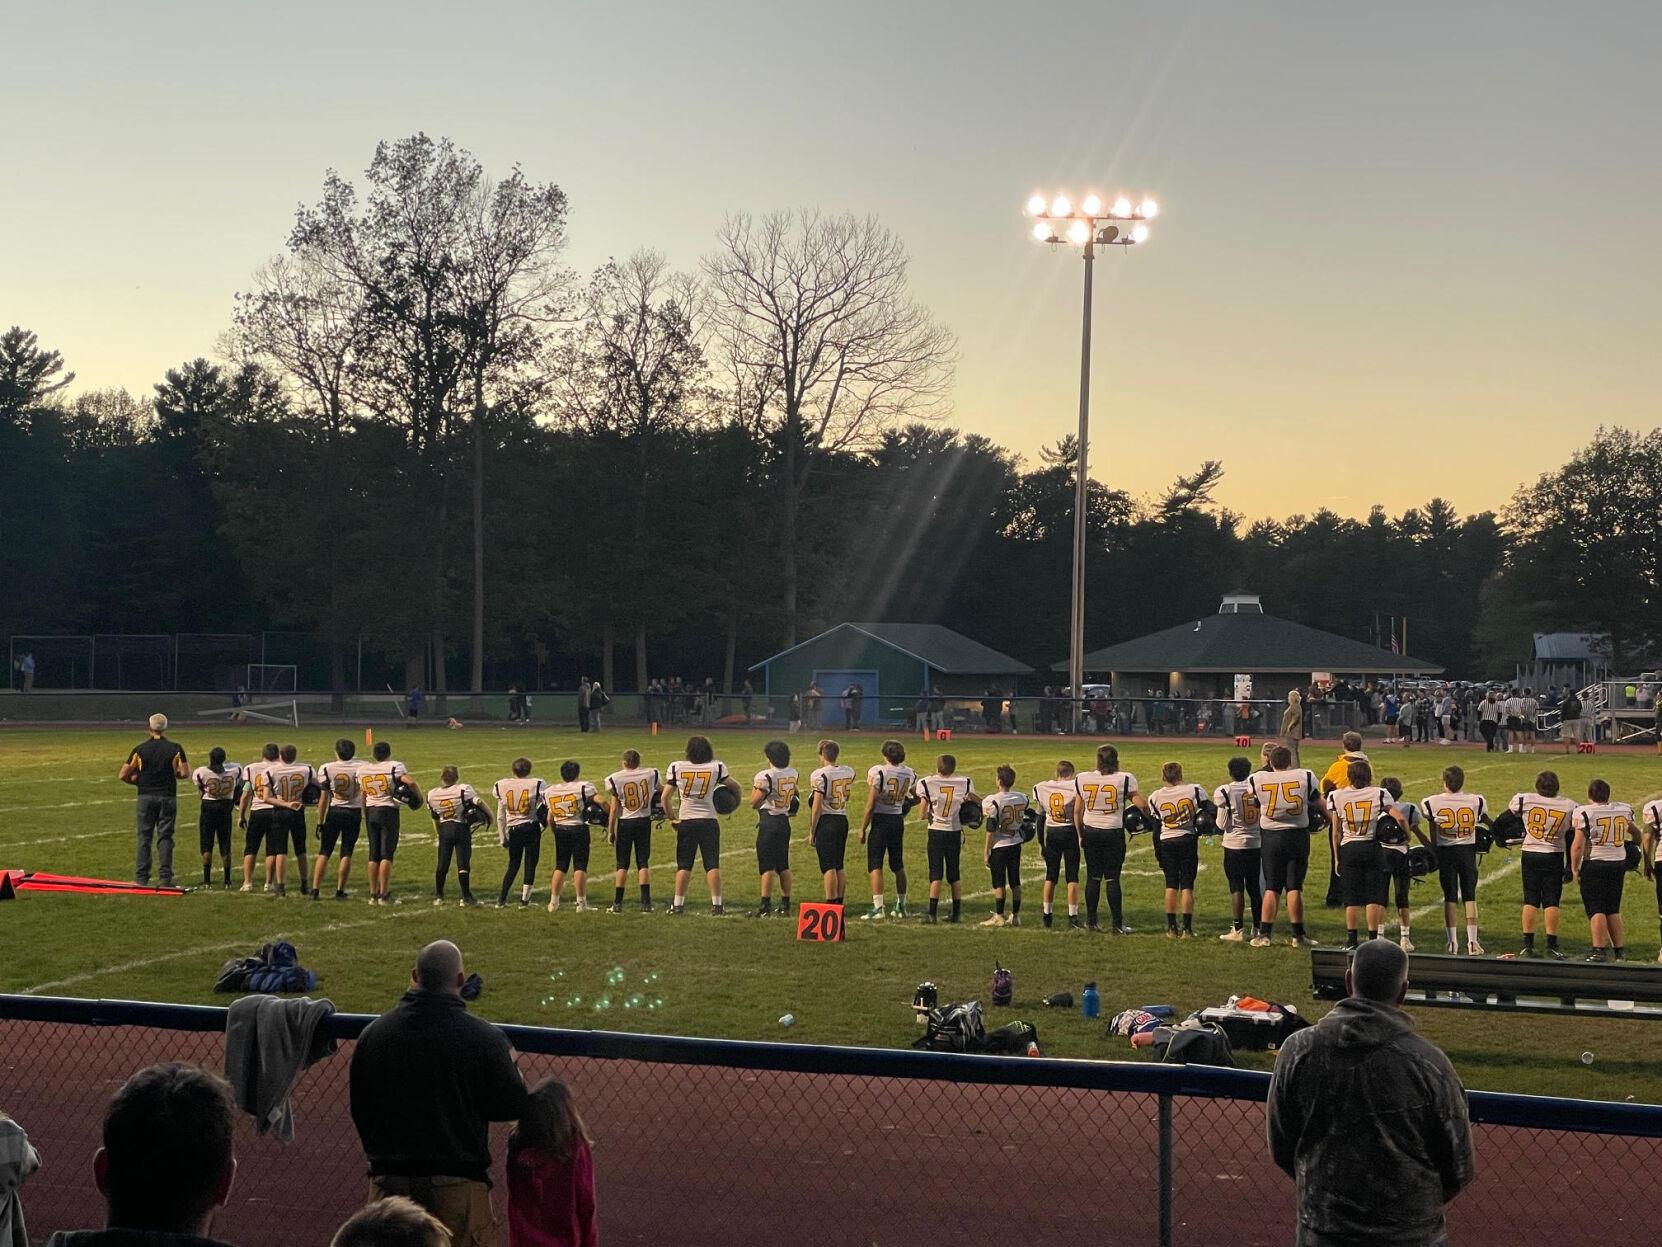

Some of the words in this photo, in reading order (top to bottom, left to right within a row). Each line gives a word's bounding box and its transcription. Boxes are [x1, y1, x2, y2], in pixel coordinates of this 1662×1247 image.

[1236, 738, 1248, 747] 10
[1580, 744, 1593, 753] 20
[623, 779, 649, 811] 81
[681, 771, 711, 799] 77
[1083, 784, 1119, 814] 73
[1261, 781, 1303, 817] 75
[506, 789, 529, 815] 14
[549, 793, 578, 817] 53
[940, 786, 954, 817] 7
[1049, 792, 1066, 823] 8
[1344, 800, 1372, 834] 17
[1527, 806, 1566, 843] 87
[1596, 815, 1628, 847] 70
[801, 909, 839, 940] 20
